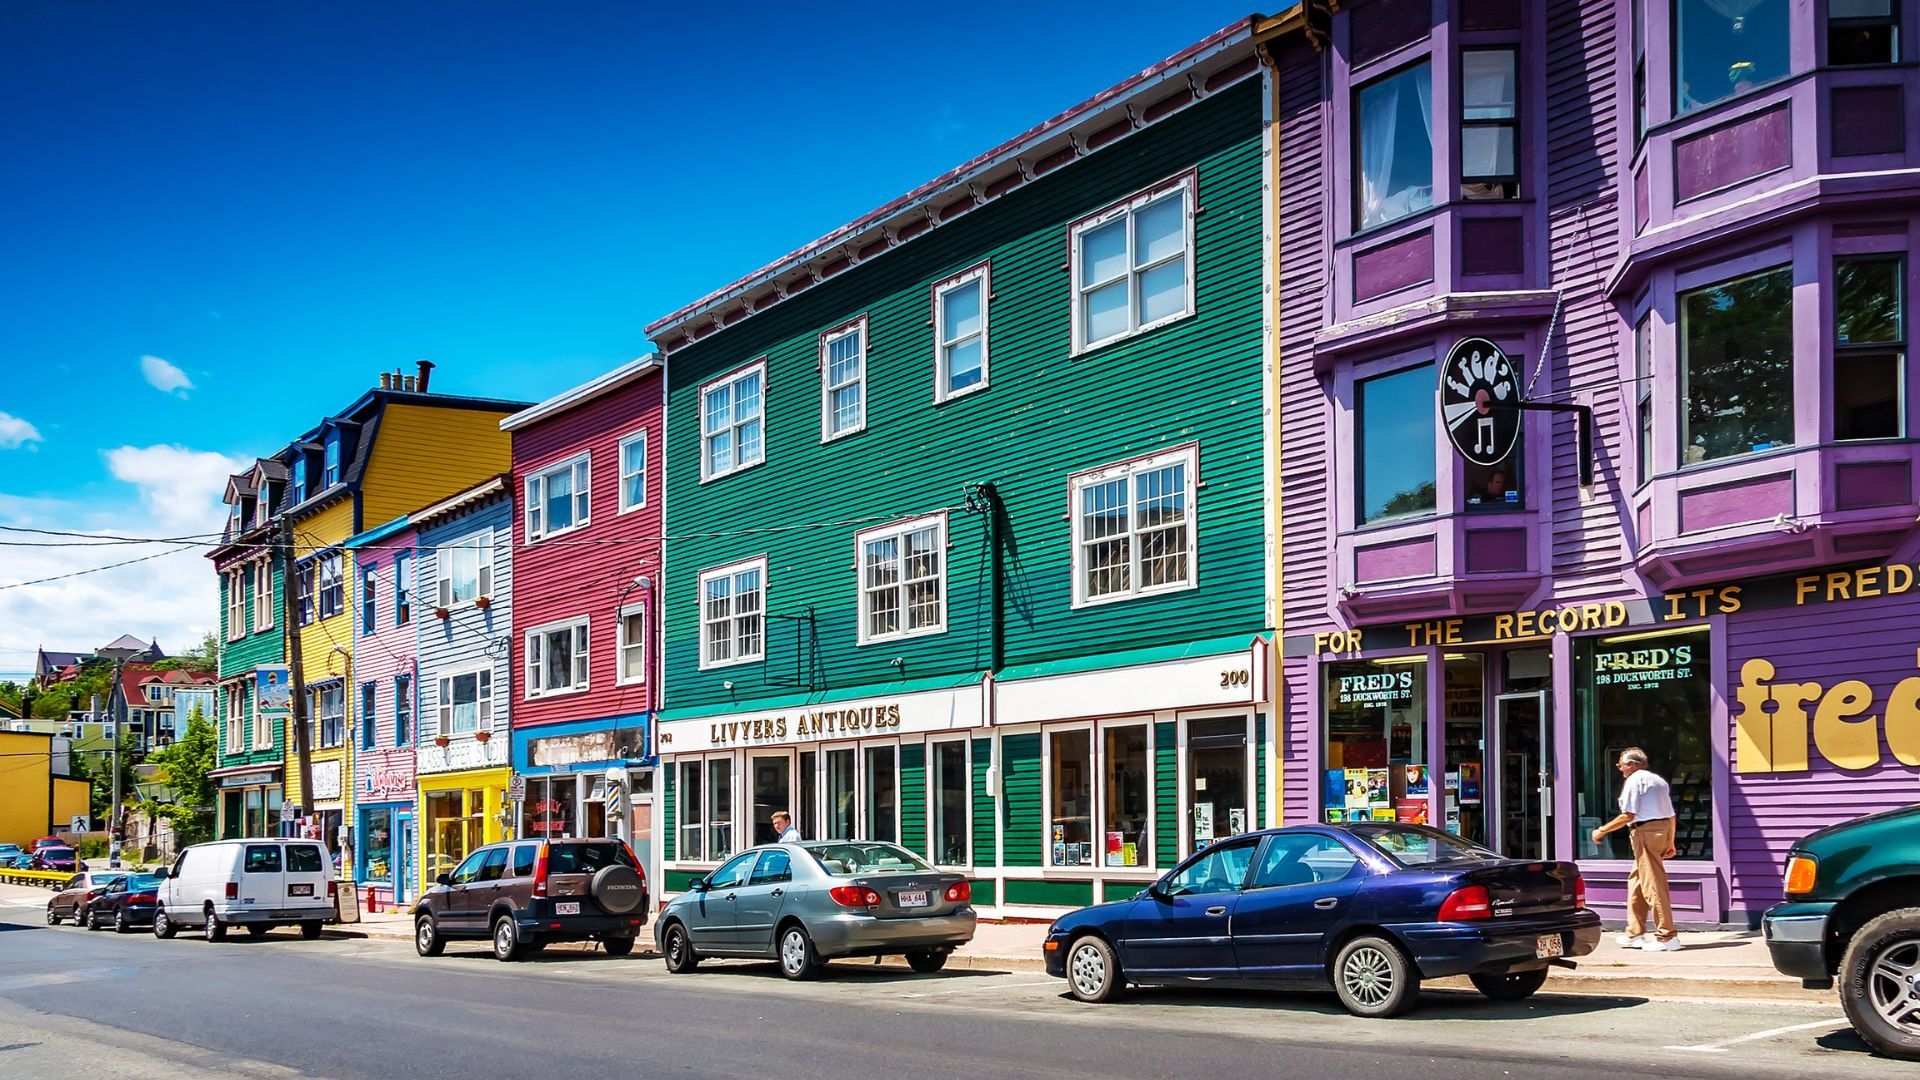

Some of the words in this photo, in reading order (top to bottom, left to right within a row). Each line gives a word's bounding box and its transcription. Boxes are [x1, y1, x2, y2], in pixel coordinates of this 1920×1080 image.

[1447, 350, 1511, 400] fred's
[1314, 629, 1363, 655] FOR
[1405, 619, 1463, 647] THE
[1494, 600, 1626, 639] RECORD
[1664, 586, 1742, 621] ITS
[1796, 563, 1920, 605] FRED
[1595, 645, 1692, 672] FRED'S
[1220, 669, 1249, 687] 200
[1339, 672, 1412, 693] FRED'S
[1596, 674, 1611, 684] 198
[1613, 669, 1674, 683] DUCKWORTH
[1677, 668, 1693, 678] ST.
[1340, 694, 1352, 703] 198
[1353, 690, 1399, 702] DUCKWORTH
[1400, 689, 1412, 698] ST.
[711, 717, 787, 744] LIVYERS
[797, 704, 901, 736] ANTIQUES
